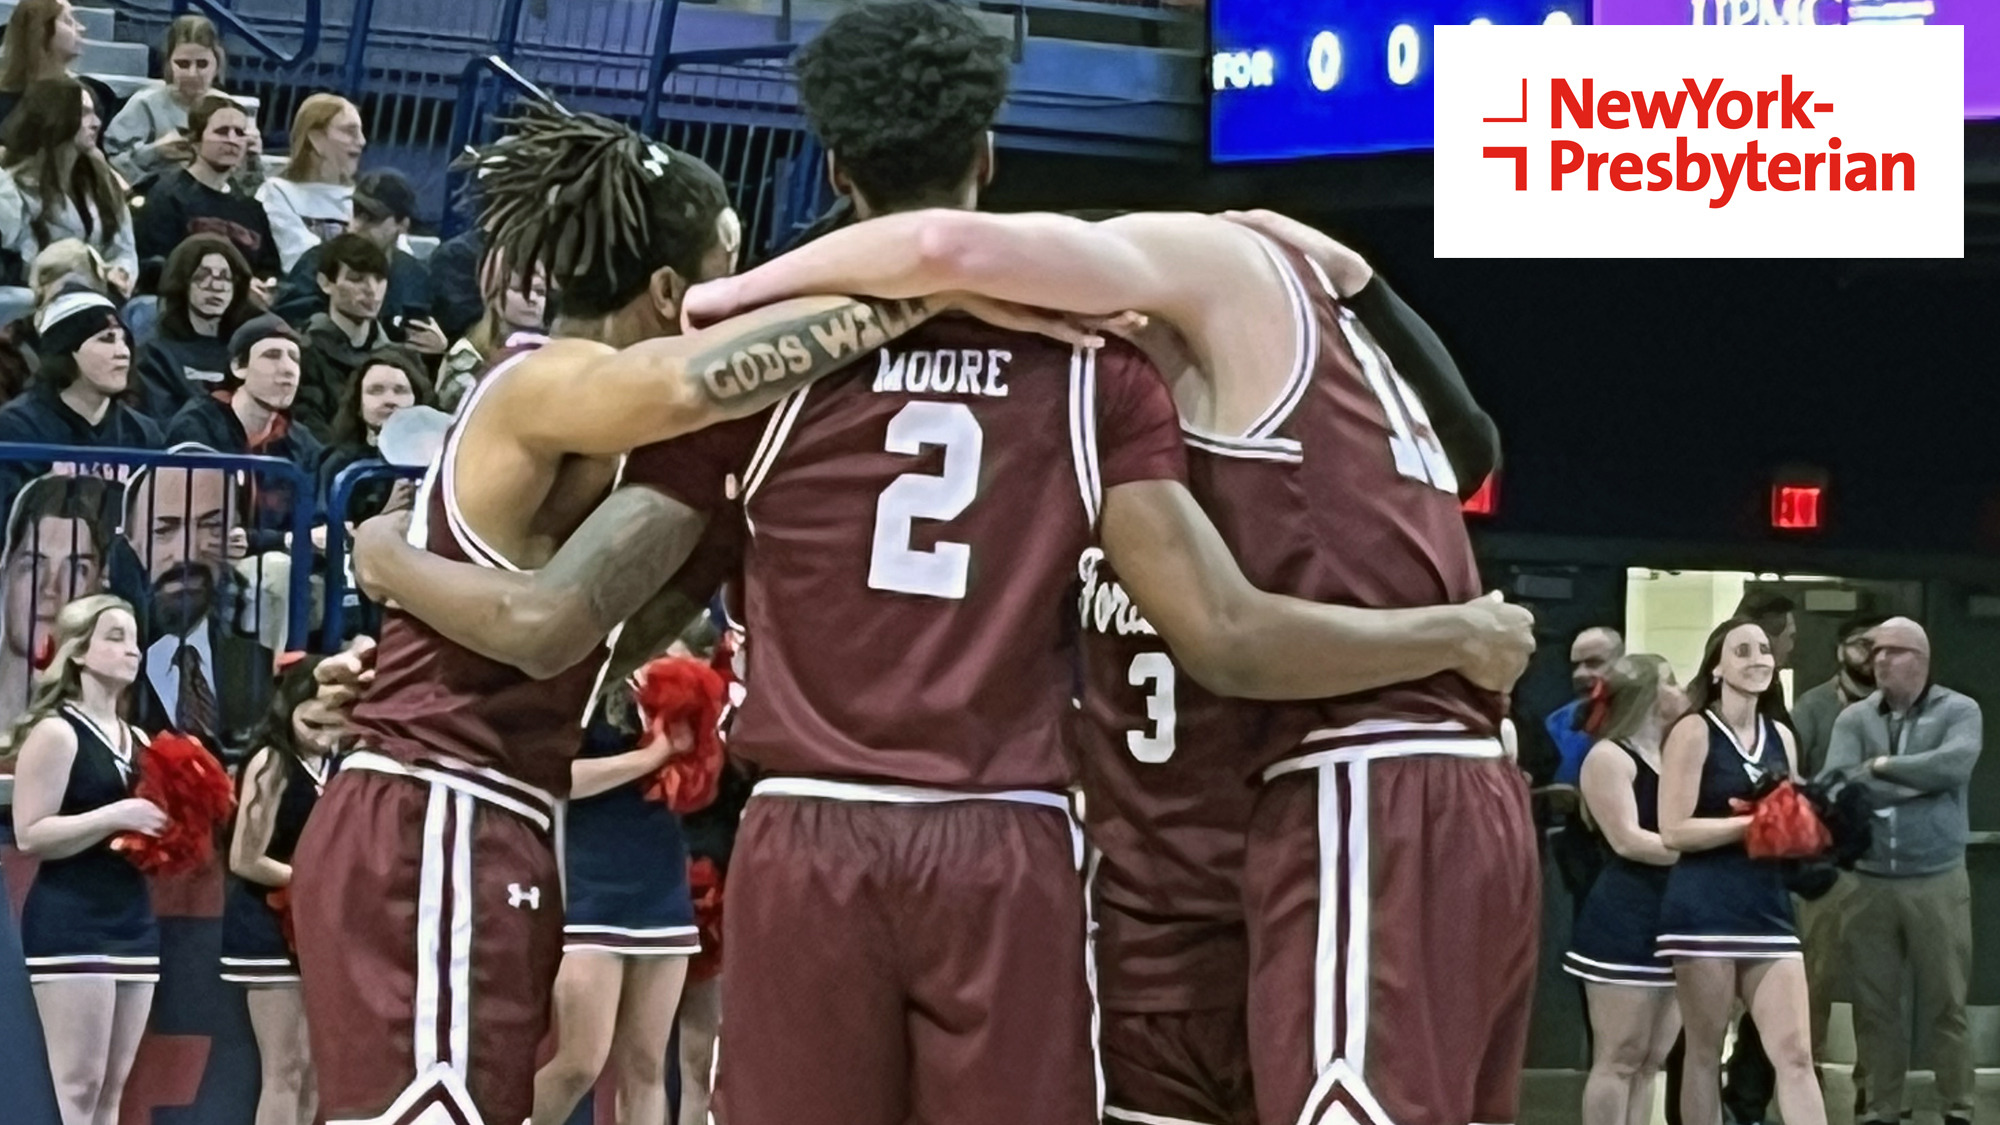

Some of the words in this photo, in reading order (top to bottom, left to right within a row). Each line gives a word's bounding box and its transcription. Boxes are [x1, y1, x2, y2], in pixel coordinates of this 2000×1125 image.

[1212, 50, 1274, 90] FOR
[1308, 30, 1342, 91] 0
[1387, 23, 1420, 85] 0
[703, 334, 813, 399] GODS
[809, 299, 928, 360] WILL
[872, 347, 1012, 398] MOORE
[867, 400, 984, 599] 2
[1126, 652, 1177, 763] 3
